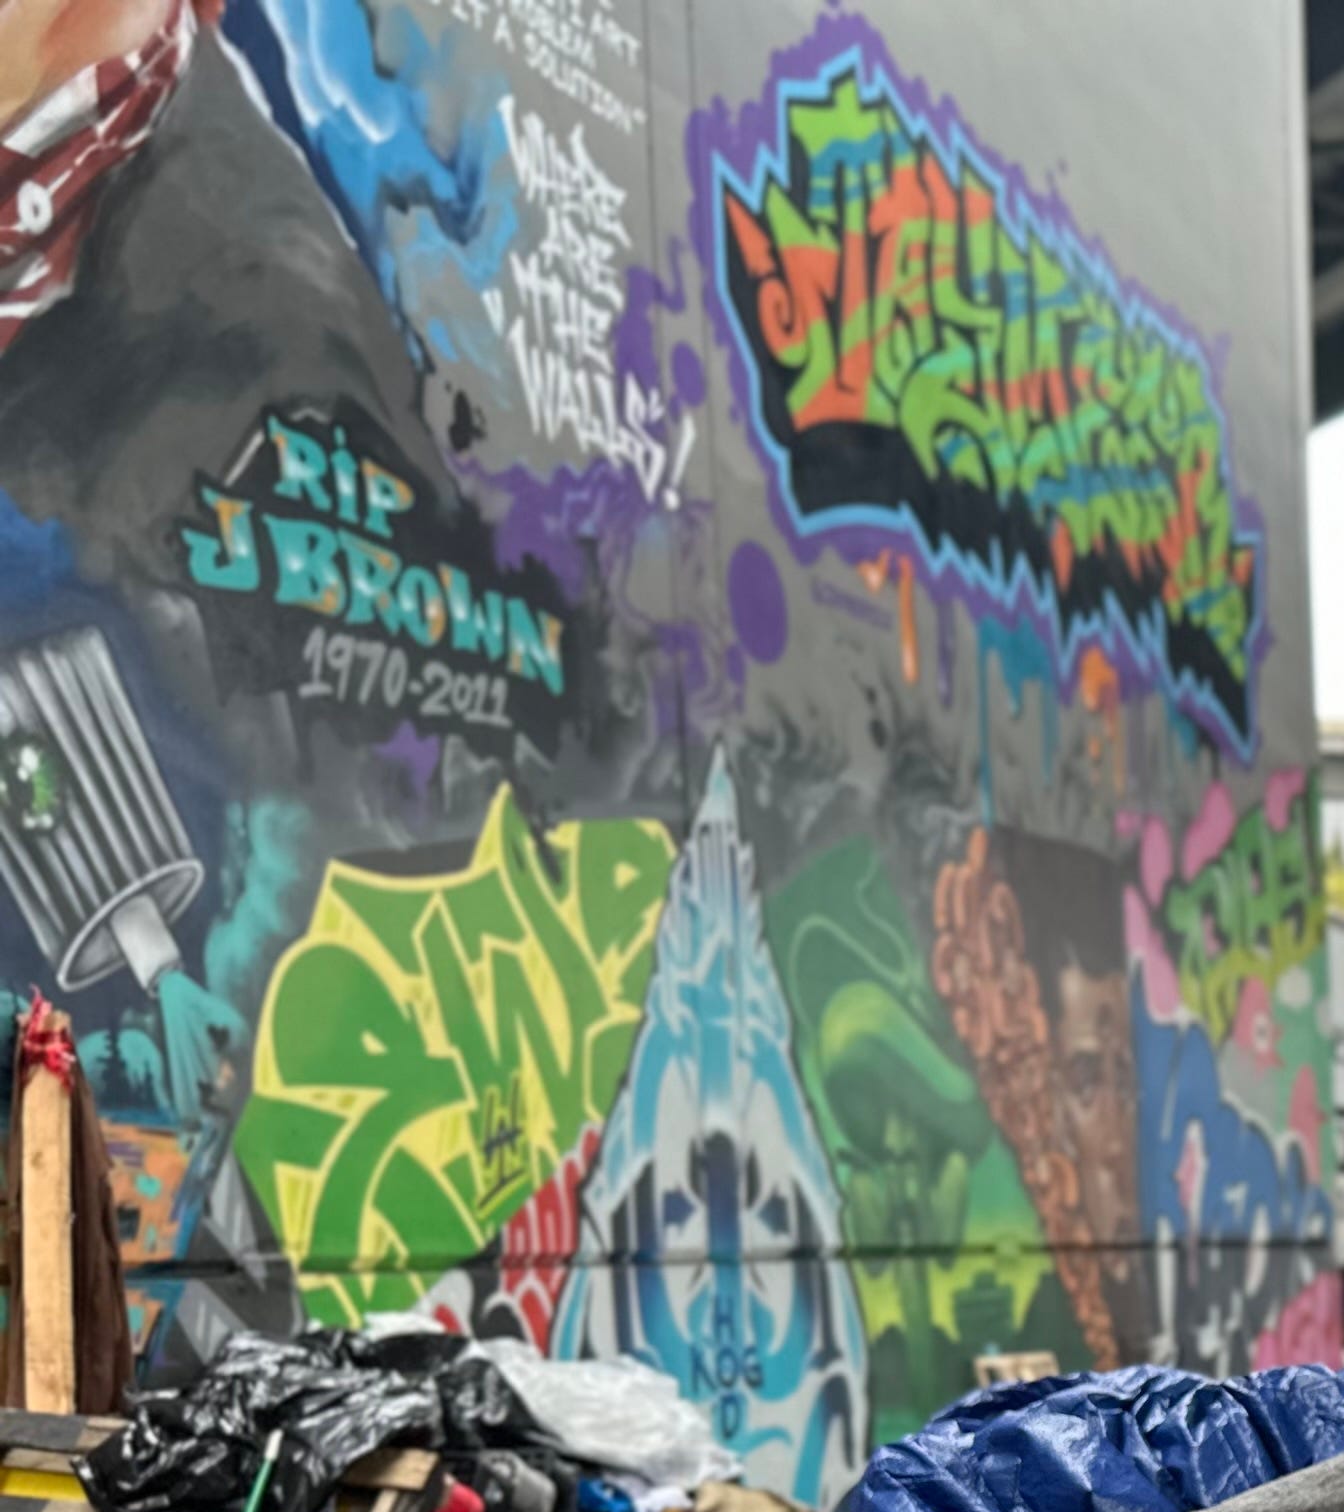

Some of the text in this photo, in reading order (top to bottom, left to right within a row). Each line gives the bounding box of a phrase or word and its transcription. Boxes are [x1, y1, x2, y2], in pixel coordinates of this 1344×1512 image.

[498, 94, 632, 250] WHERE
[509, 250, 614, 376] THE
[540, 204, 626, 308] ARE
[181, 486, 564, 696] J BROWN
[299, 626, 514, 728] 1970-2011
